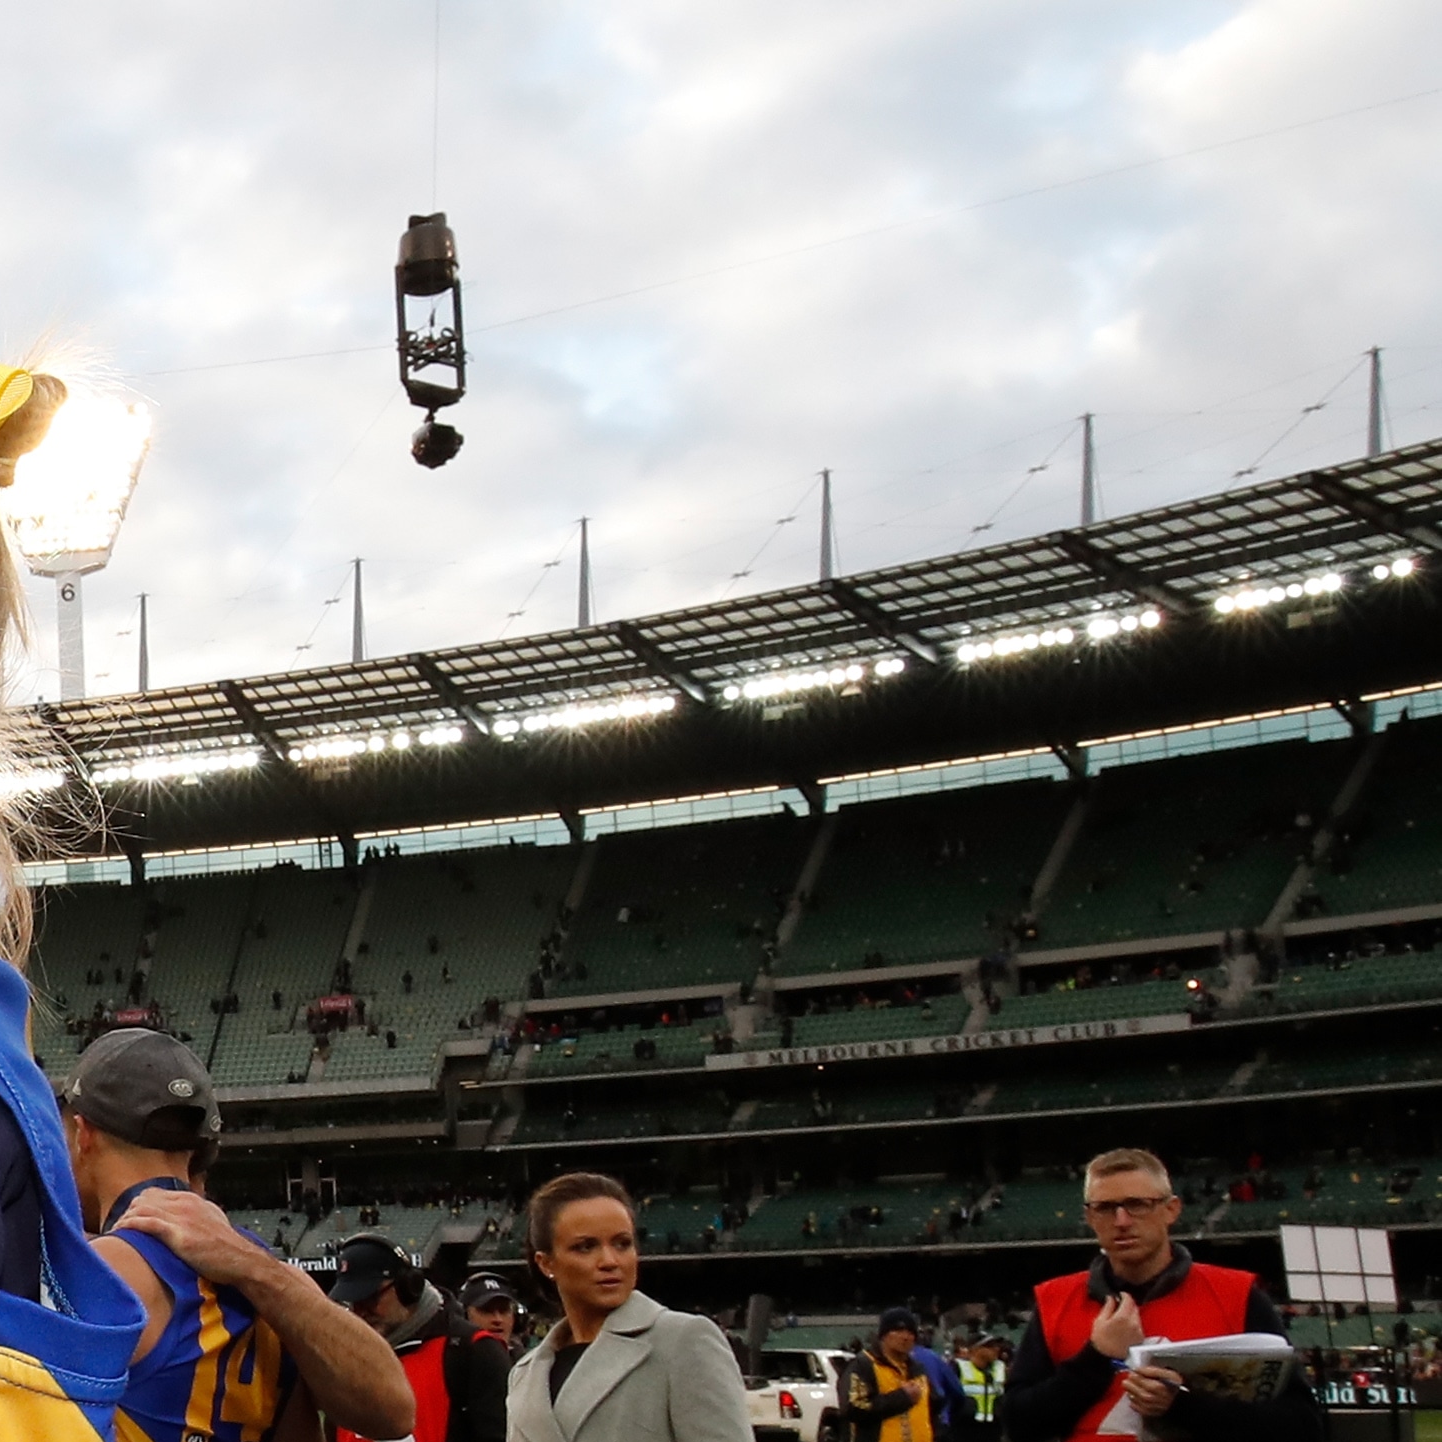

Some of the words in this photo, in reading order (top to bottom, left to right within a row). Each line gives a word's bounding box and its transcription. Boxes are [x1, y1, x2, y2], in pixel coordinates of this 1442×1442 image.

[768, 1040, 915, 1066] MELBOURNE
[930, 1028, 1037, 1053] CRICKET
[1053, 1022, 1117, 1042] CLUB
